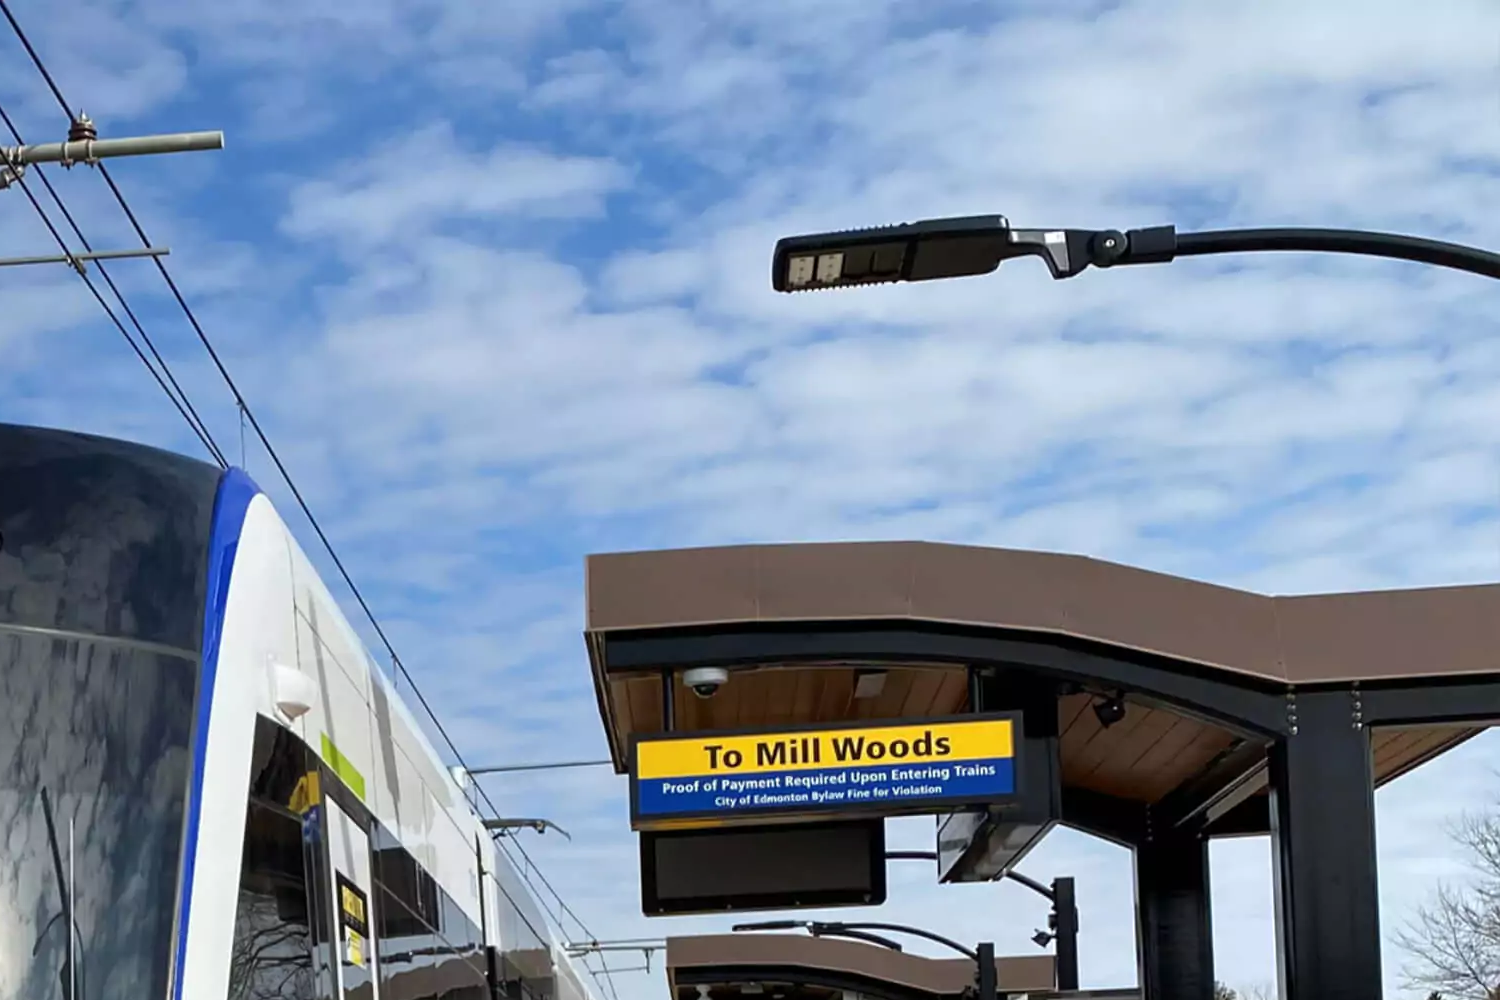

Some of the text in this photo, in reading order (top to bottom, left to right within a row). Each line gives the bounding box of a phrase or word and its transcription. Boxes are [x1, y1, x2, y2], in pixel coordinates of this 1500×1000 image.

[704, 730, 951, 769] To Mill Woods
[662, 764, 996, 794] Proof of Payment Required Upon Entering Trains
[715, 784, 942, 808] City of Edmonton Bylaw Fine for Violation
